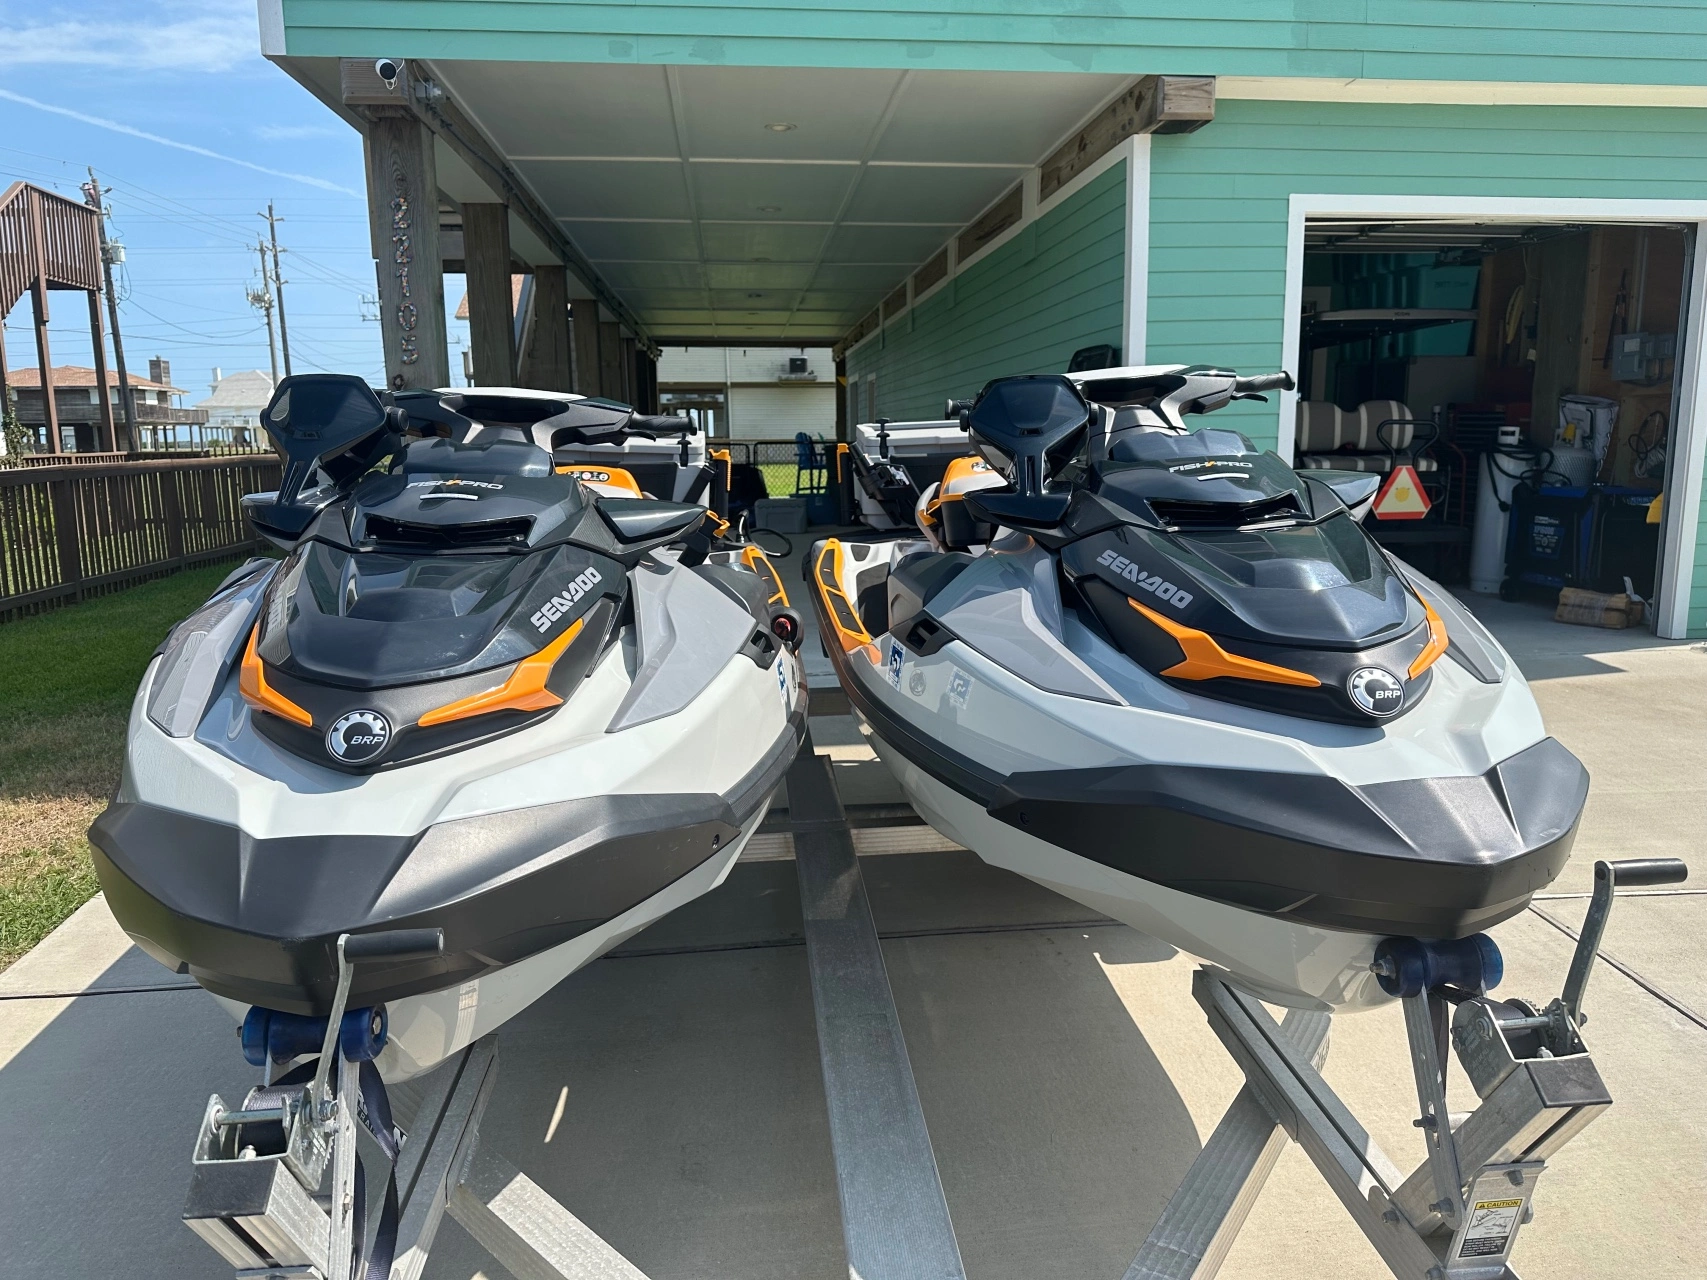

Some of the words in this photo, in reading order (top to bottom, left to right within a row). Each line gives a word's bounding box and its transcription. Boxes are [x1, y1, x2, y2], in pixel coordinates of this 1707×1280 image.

[1375, 689, 1401, 700] BRP
[350, 735, 384, 745] BRP
[1486, 1200, 1519, 1209] CAUTION
